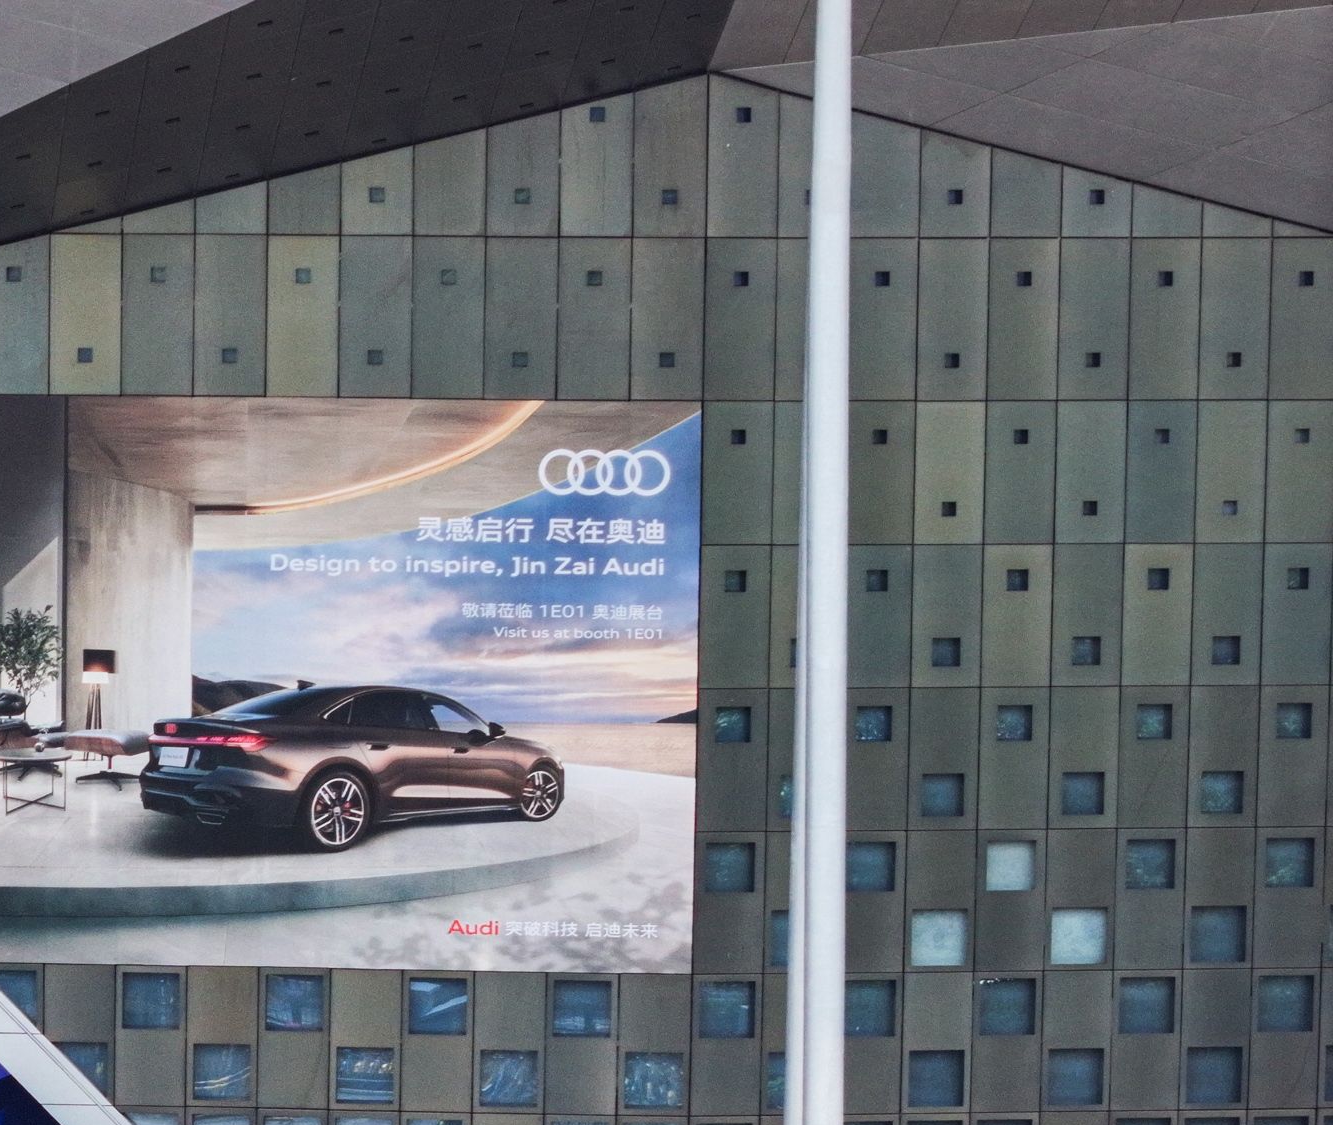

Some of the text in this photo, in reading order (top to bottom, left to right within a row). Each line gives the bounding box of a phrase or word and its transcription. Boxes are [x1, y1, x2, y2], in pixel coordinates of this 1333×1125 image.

[416, 516, 666, 545] 灵感启行 尽在奥迪
[270, 554, 665, 577] Design to inspire, Jin Zai Audi
[462, 602, 664, 621] 敬请莅临 1E01 奥迪展台
[494, 626, 663, 640] Visit us at booth 1E01
[448, 919, 659, 939] Audi 突破科技 启迪未来
